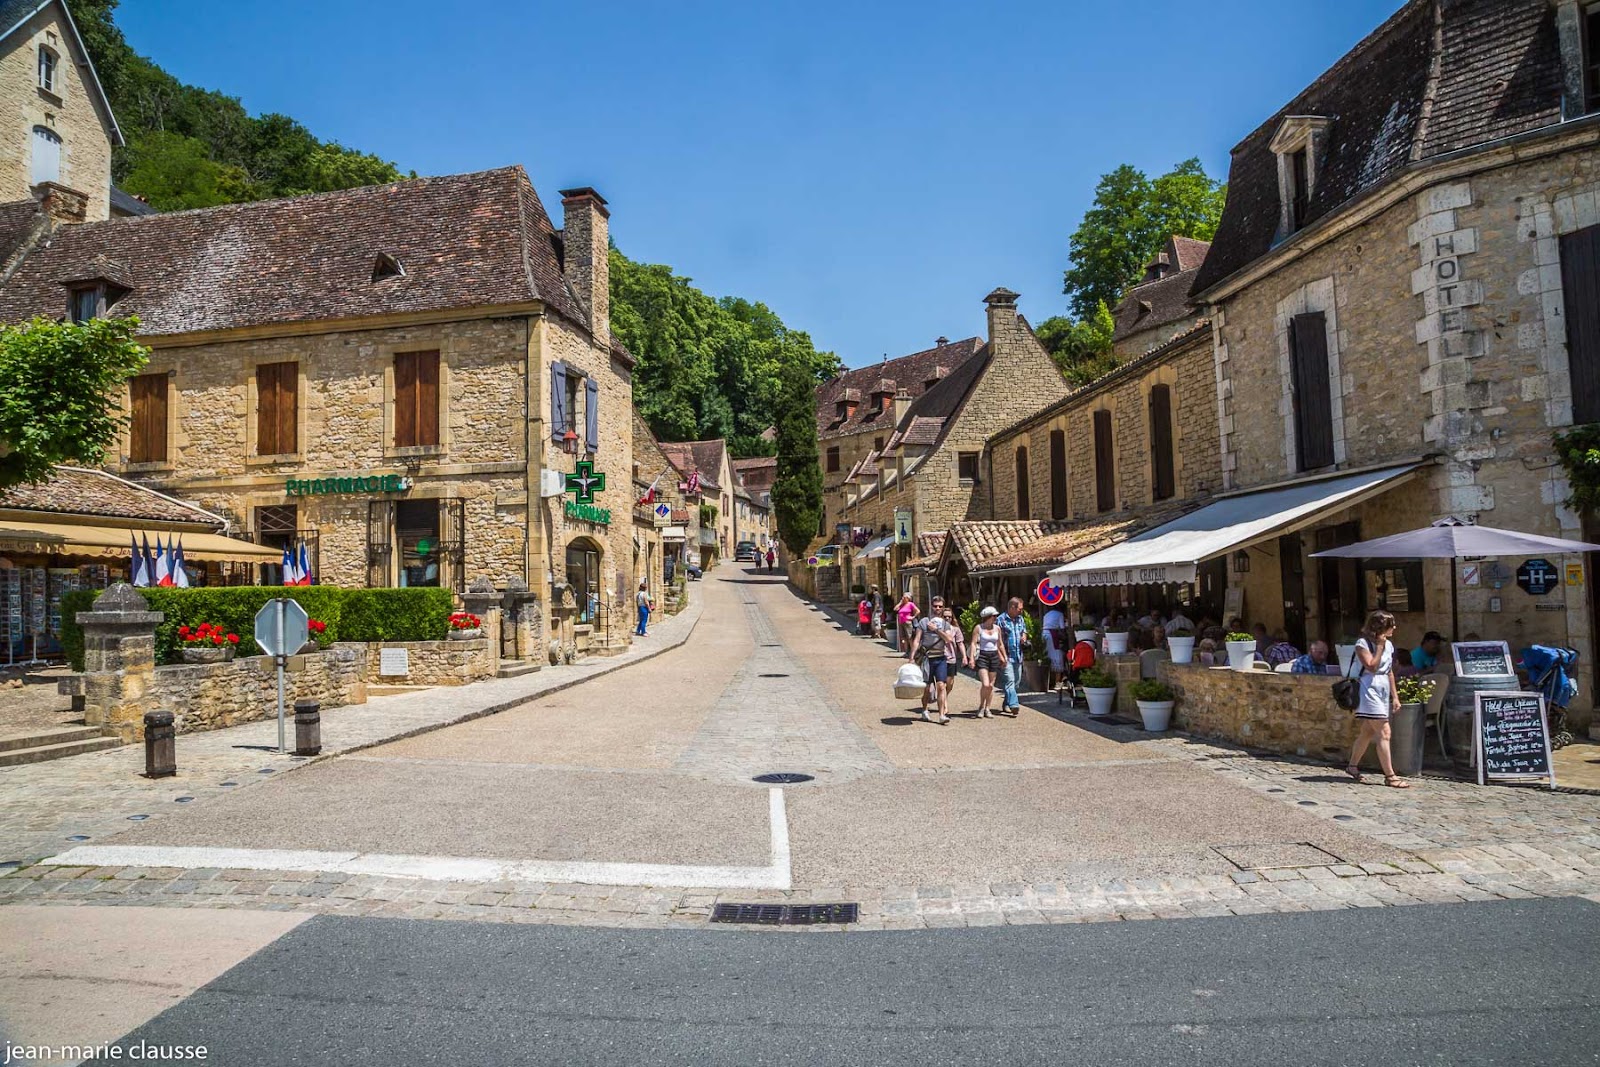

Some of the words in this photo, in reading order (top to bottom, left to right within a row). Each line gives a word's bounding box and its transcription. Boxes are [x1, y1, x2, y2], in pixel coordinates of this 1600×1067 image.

[1435, 234, 1462, 358] HOTEL
[286, 474, 400, 496] PHARMACIE
[565, 500, 612, 525] PHARMACIE
[1087, 570, 1119, 584] RESTAURANT
[1125, 569, 1133, 582] DU
[1140, 567, 1166, 581] CHATEAU
[1530, 570, 1545, 584] H
